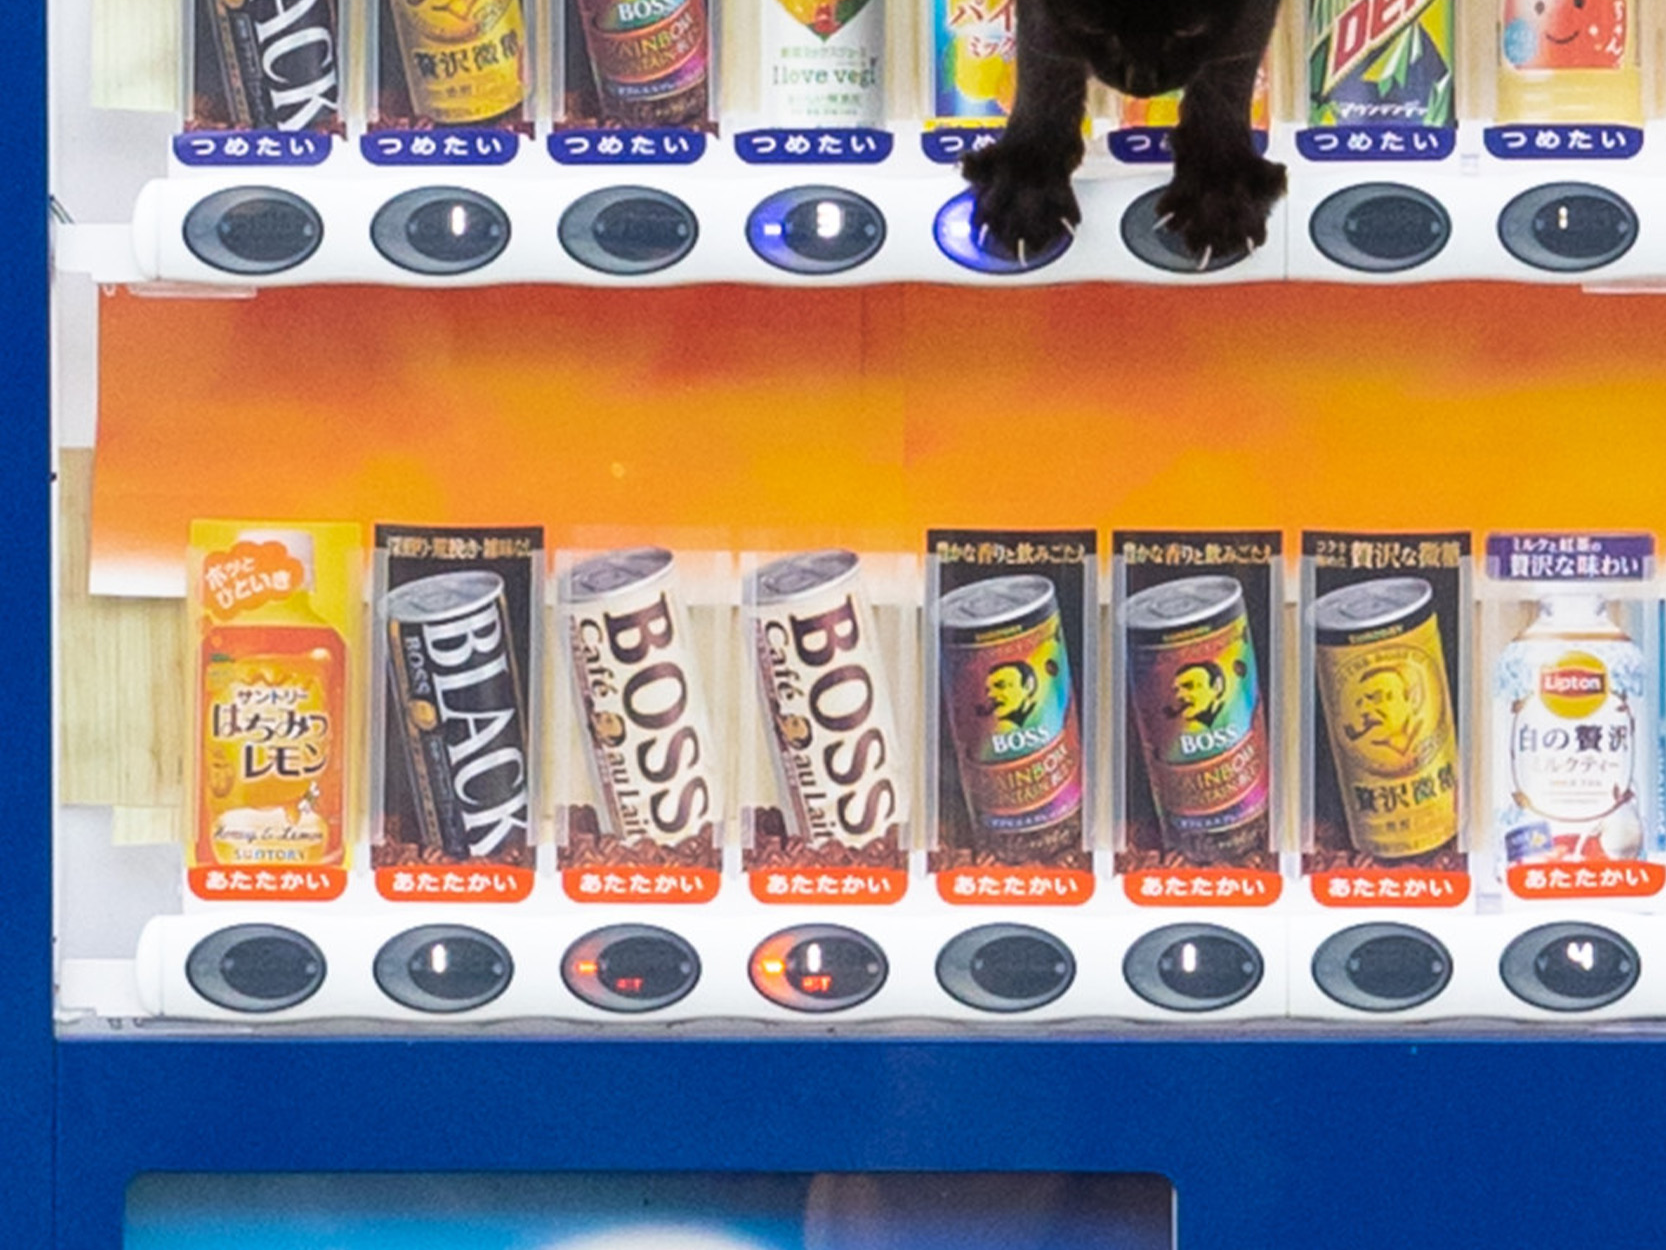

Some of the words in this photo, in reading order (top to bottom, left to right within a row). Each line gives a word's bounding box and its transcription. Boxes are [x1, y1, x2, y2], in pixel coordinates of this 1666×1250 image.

[191, 136, 315, 156] つめたい
[377, 136, 501, 156] つめたい
[564, 135, 689, 155] つめたい
[751, 135, 876, 155] つめたい
[1313, 131, 1439, 152] つめたい
[1501, 130, 1627, 150] つめたい
[1509, 556, 1640, 578] 贅沢な味わい
[1544, 673, 1601, 691] Lipton
[237, 689, 309, 703] サントリー
[212, 703, 328, 738] はちみつ
[603, 591, 710, 835] BOSS
[789, 593, 896, 836] BOSS
[423, 600, 528, 858] BLACK
[992, 725, 1052, 754] BOSS
[1179, 724, 1240, 755] BOSS
[1518, 724, 1629, 753] 白の贅沢
[243, 745, 328, 779] レモン
[206, 870, 330, 891] あたたかい
[393, 870, 517, 892] あたたかい
[579, 873, 704, 894] あたたかい
[766, 873, 891, 895] あたたかい
[953, 874, 1079, 896] あたたかい
[1140, 874, 1266, 896] あたたかい
[1328, 876, 1453, 897] あたたかい
[1524, 867, 1650, 889] あたたかい
